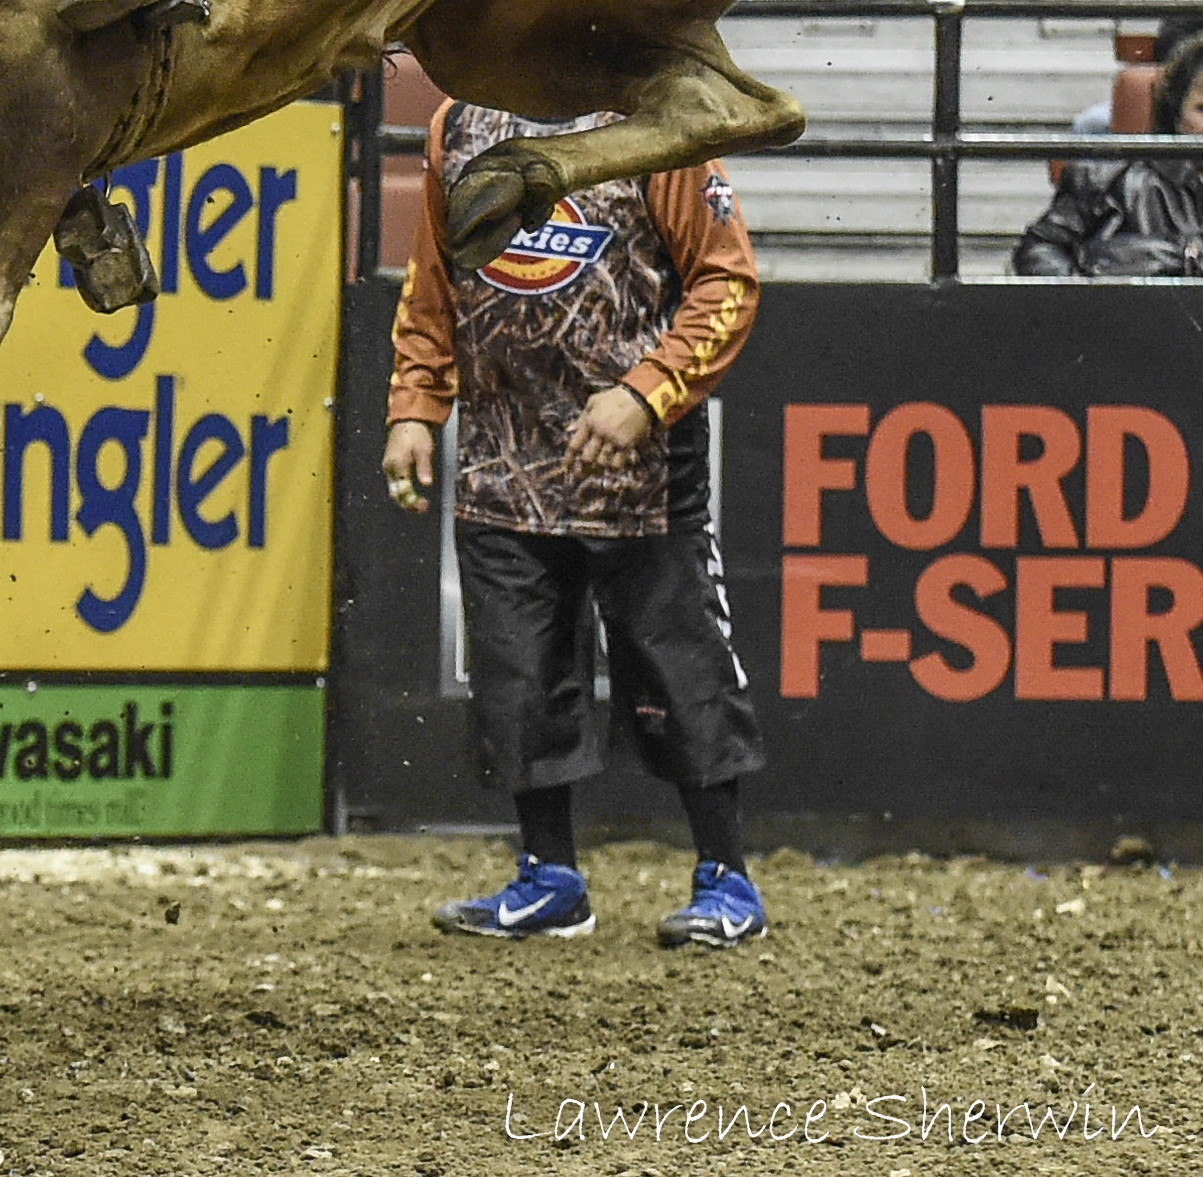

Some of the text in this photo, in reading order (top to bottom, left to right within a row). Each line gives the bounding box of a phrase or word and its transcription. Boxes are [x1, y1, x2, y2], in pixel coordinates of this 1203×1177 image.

[509, 226, 593, 255] kies
[783, 401, 1190, 551] FORD
[780, 552, 1203, 702] F-SER
